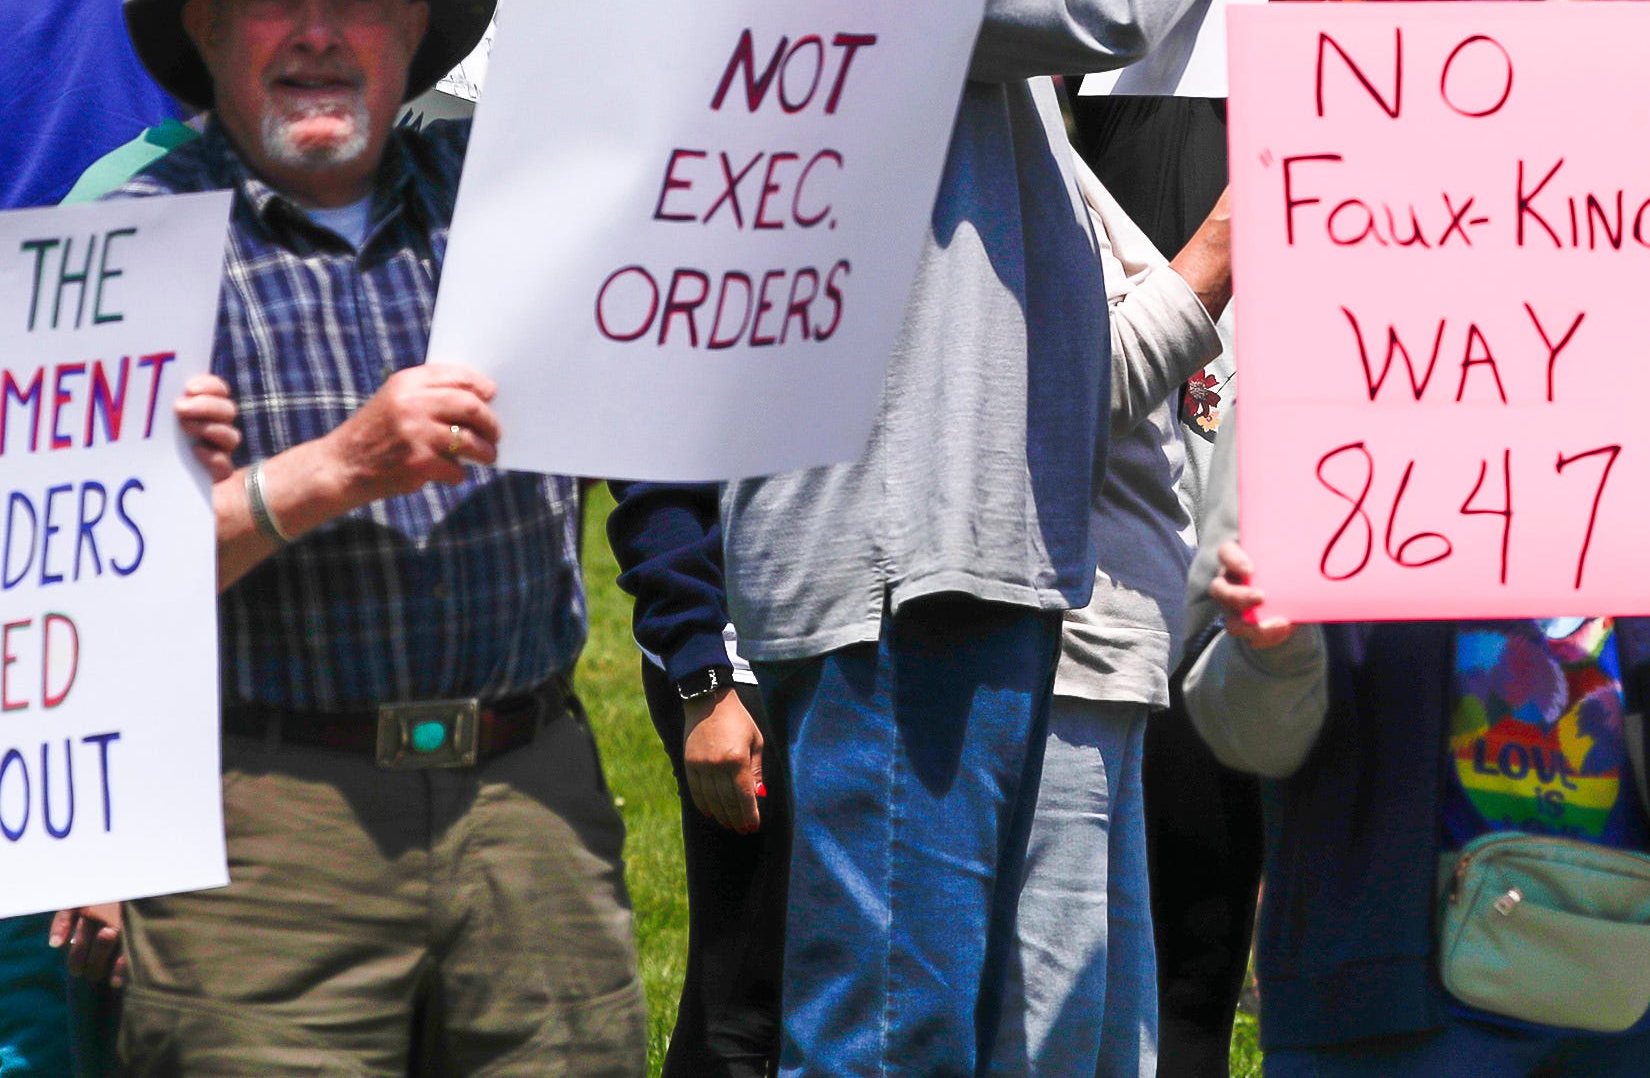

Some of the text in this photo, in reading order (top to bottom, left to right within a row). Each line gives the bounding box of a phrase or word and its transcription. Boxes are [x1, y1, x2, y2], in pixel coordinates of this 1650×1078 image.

[710, 27, 877, 115] NOT
[1315, 26, 1514, 119] NO
[653, 148, 845, 231] EXEC.
[20, 227, 138, 333] THE
[595, 259, 852, 351] ORDERS
[0, 351, 176, 457] MENT
[1340, 302, 1588, 405] WAY
[2, 478, 147, 591] DERS
[1315, 440, 1622, 590] 8647
[1, 612, 80, 713] ED
[0, 731, 121, 842] OUT
